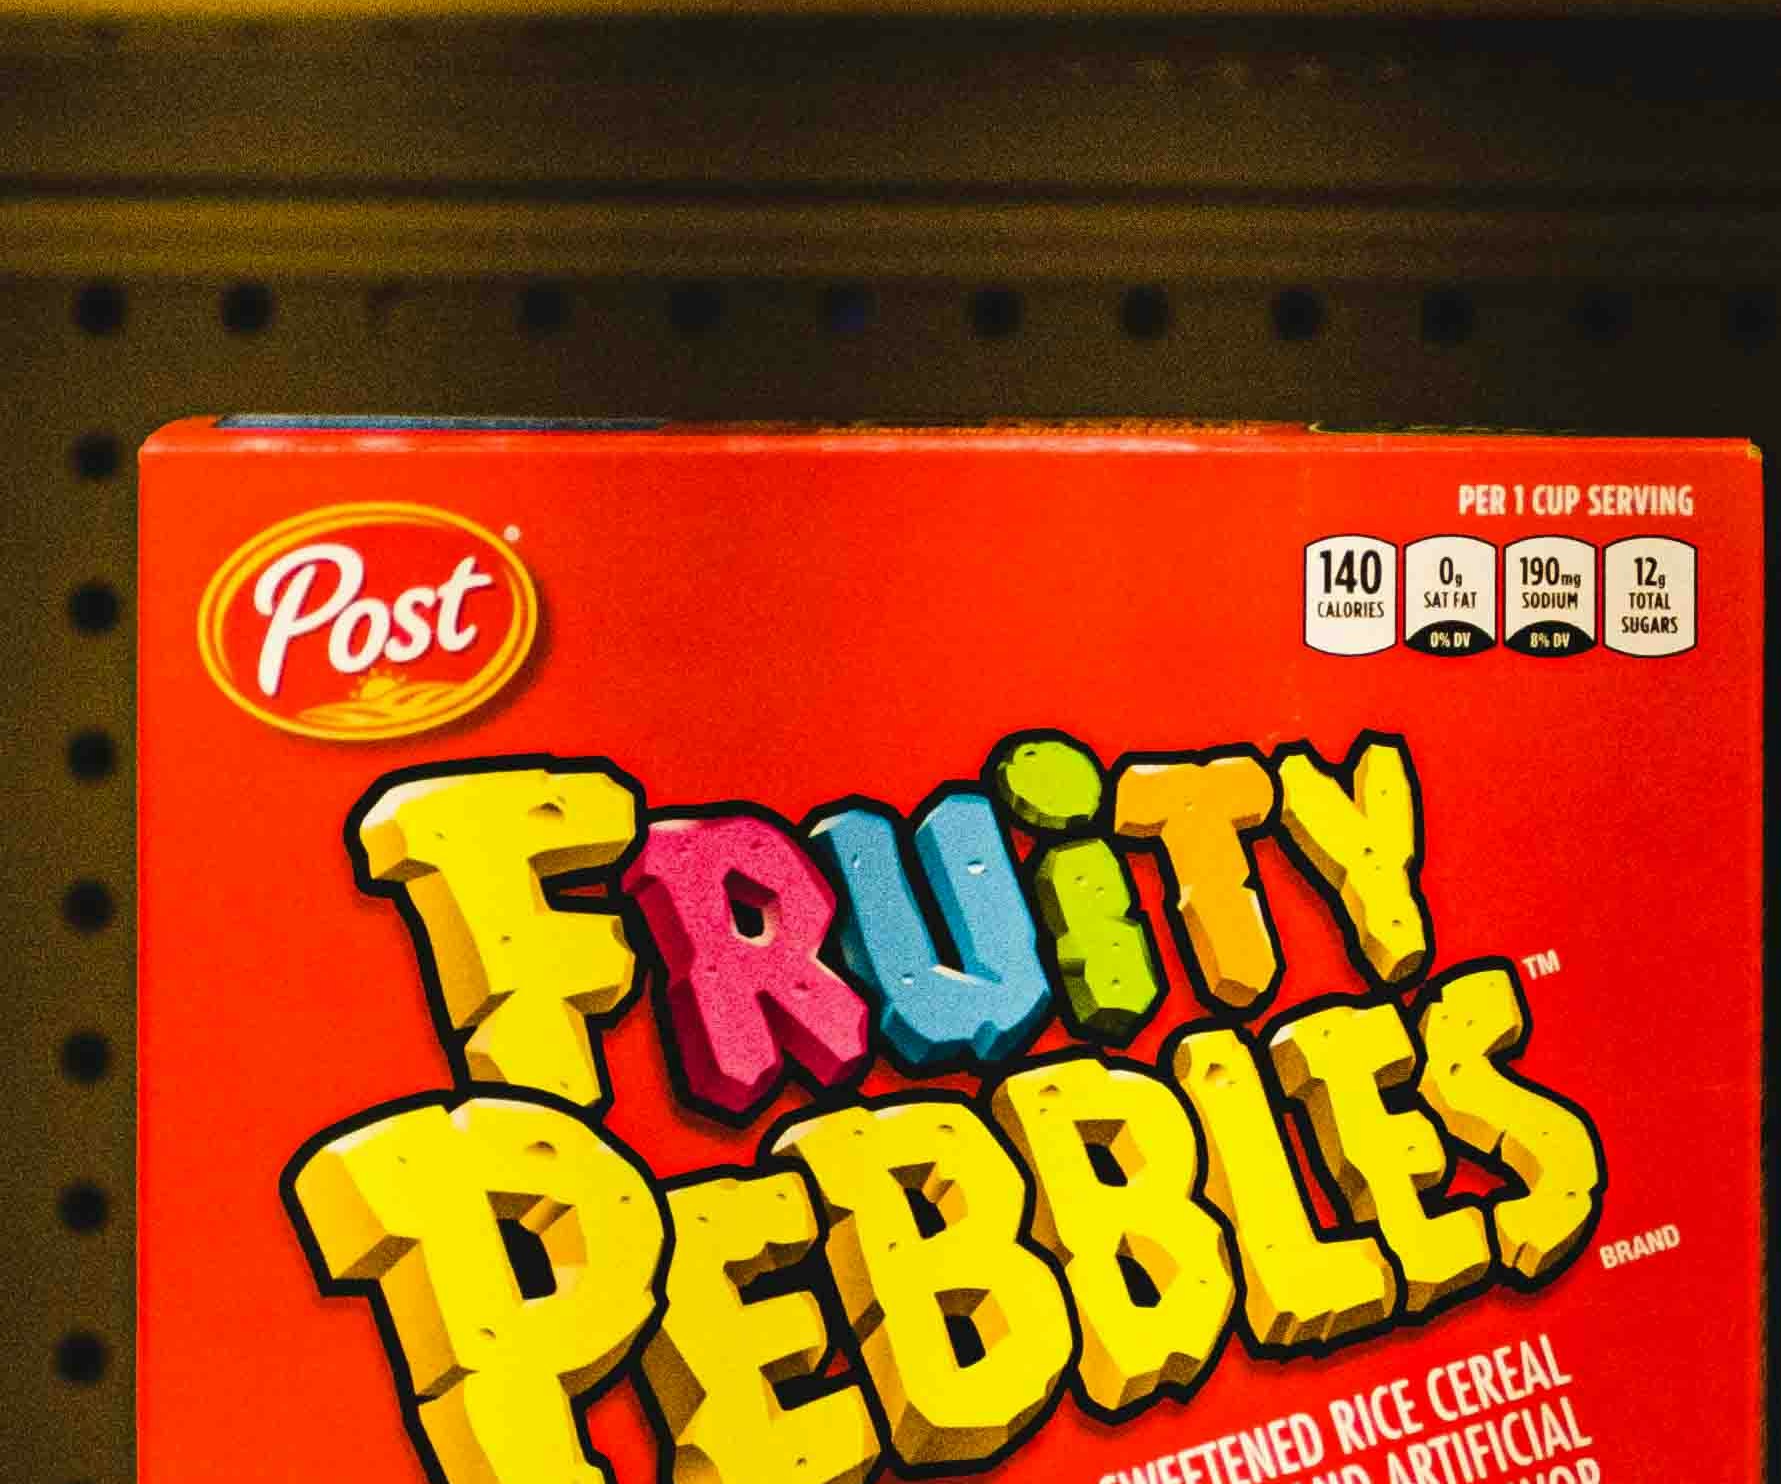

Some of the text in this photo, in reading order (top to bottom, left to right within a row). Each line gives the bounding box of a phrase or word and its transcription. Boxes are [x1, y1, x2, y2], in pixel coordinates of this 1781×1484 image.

[1459, 484, 1694, 517] PER 1 CUP SERVING
[1319, 549, 1382, 595] 140
[1439, 556, 1463, 588] 0g
[1519, 556, 1581, 588] 190mg
[1634, 556, 1666, 588] 12g
[1317, 601, 1385, 619] CALORIES
[1424, 591, 1477, 609] SAT FAT
[1522, 591, 1578, 610] SODIUM
[1628, 592, 1671, 610] TOTAL
[253, 542, 494, 697] Post
[1622, 616, 1678, 635] SUGARS
[1430, 631, 1472, 648] 0% DV
[1553, 632, 1570, 648] DV
[1599, 1224, 1681, 1270] BRAND
[1329, 1379, 1422, 1454] RICE
[1426, 1333, 1573, 1416] CEREAL
